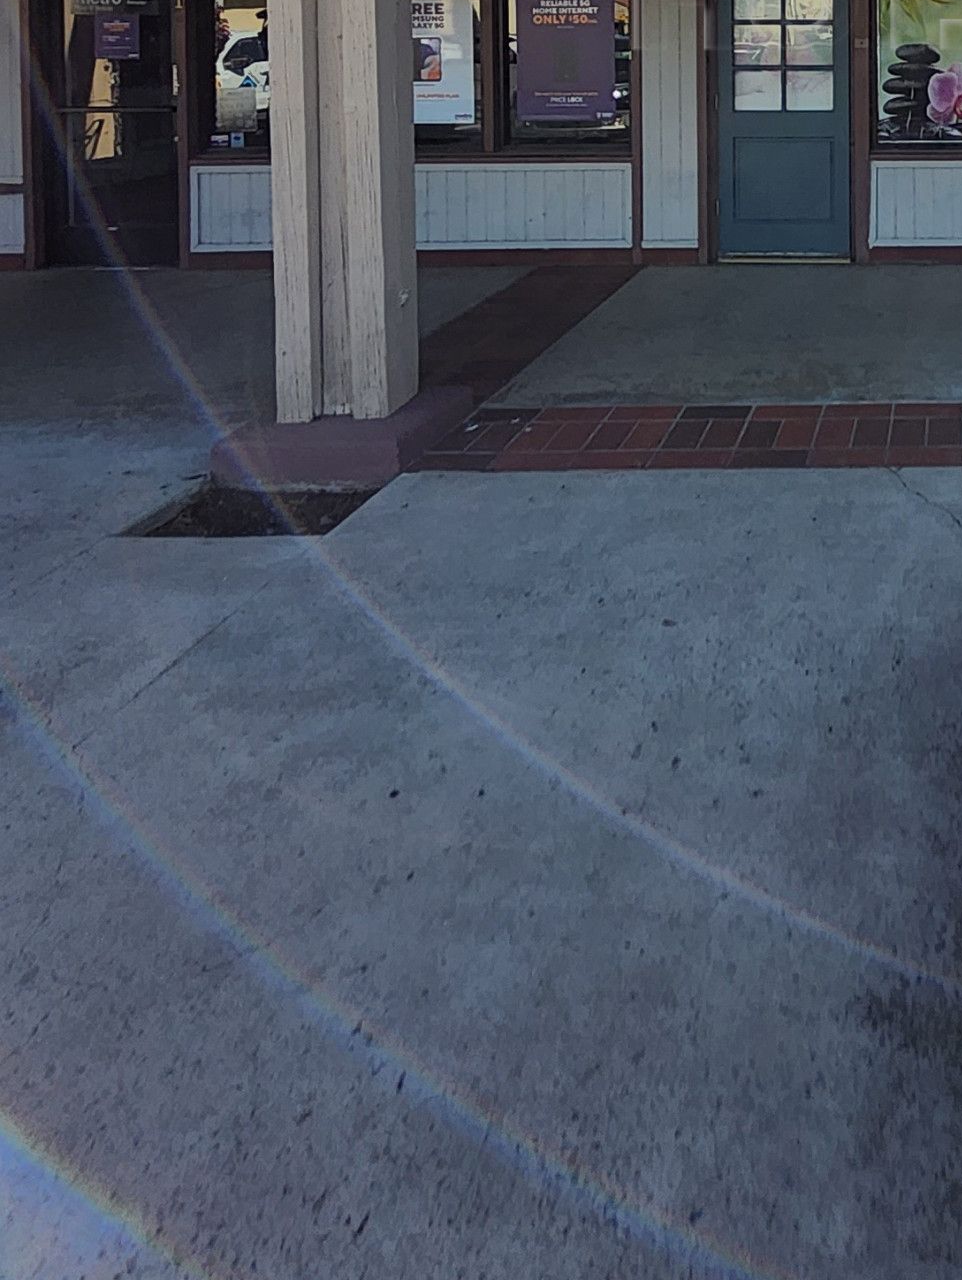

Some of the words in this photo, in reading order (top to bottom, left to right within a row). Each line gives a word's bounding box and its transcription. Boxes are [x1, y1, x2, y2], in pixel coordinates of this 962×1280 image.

[540, 0, 578, 7] RELIABLE
[532, 6, 557, 15] HOME
[558, 6, 599, 15] INTERNET
[532, 14, 566, 25] ONLY
